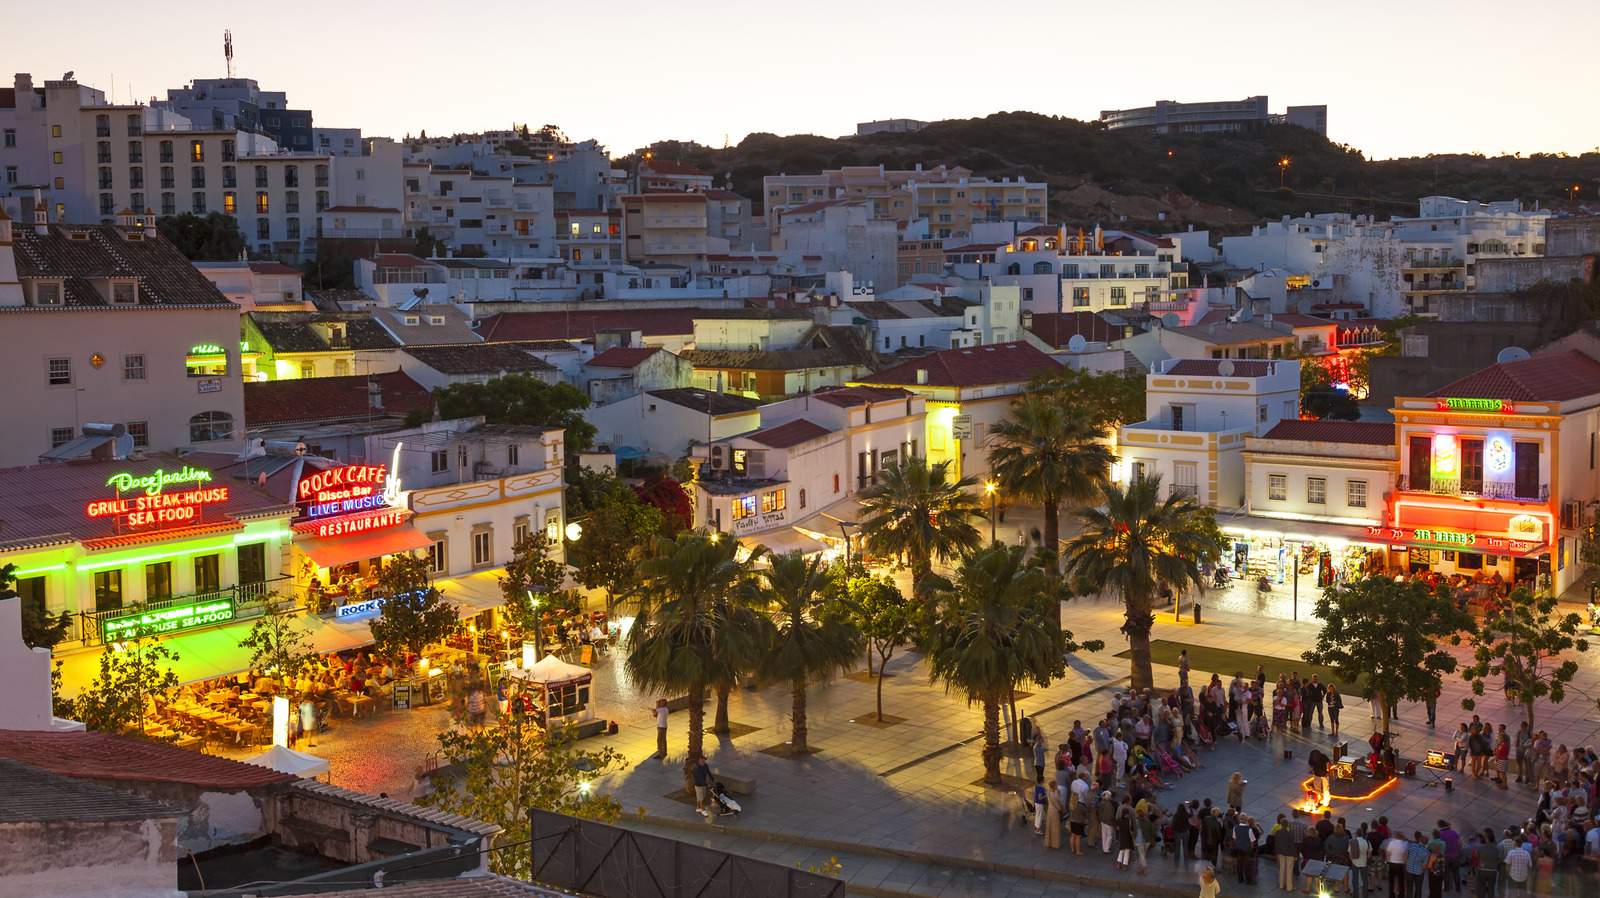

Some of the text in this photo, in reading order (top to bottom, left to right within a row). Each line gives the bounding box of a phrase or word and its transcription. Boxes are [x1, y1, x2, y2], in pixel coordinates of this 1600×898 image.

[105, 465, 212, 496] Doce Jardim
[300, 463, 386, 498] ROCK CAFÉ
[87, 487, 229, 517] GRILL STEAK-HOUSE
[319, 486, 372, 502] Disco Bar
[128, 506, 194, 526] SEA FOOD
[309, 494, 385, 517] LIVE MUSIC
[320, 513, 402, 537] RESTAURANTE
[1414, 529, 1431, 540] SIR
[1434, 531, 1476, 545] HARRY'S
[182, 611, 233, 628] SEA-FOOD
[341, 602, 375, 616] ROCK
